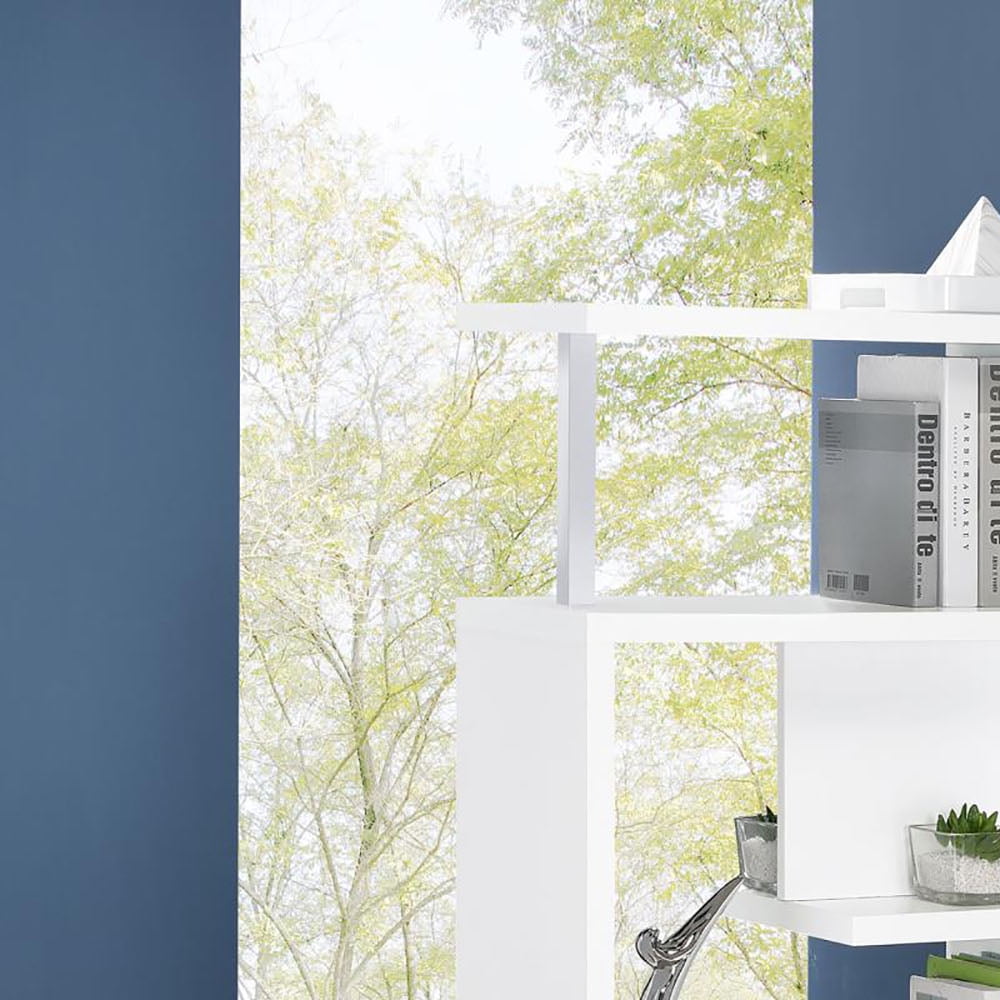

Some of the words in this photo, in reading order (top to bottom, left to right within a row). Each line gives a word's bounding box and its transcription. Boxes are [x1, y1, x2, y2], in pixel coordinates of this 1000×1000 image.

[917, 414, 938, 492] Dentro
[917, 501, 938, 522] di
[917, 534, 937, 556] te
